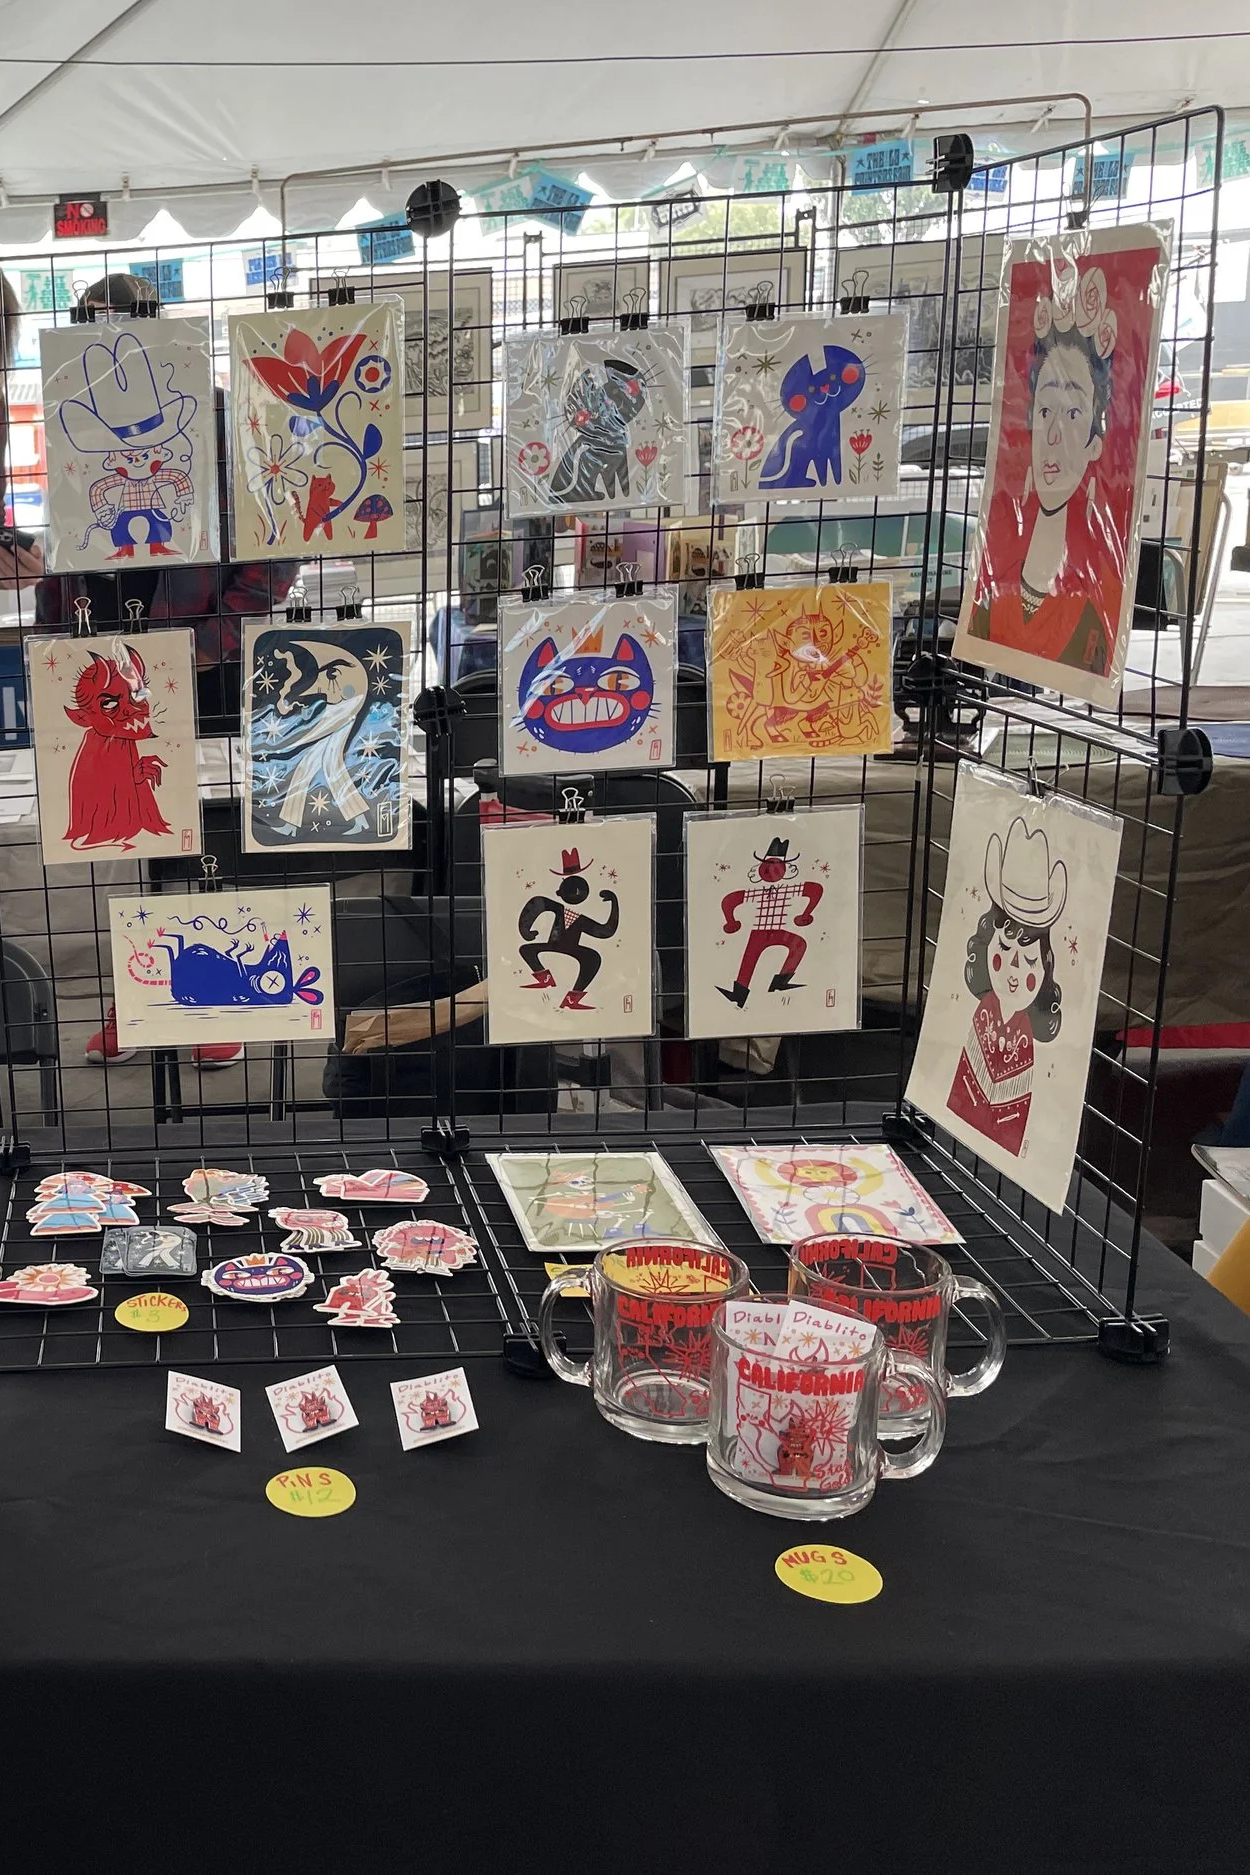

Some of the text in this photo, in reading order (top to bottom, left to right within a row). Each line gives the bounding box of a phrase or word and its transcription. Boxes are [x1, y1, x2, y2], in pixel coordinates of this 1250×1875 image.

[57, 218, 106, 237] SMOKING
[126, 1294, 187, 1312] STICKERS
[617, 1295, 723, 1328] CALIFORN
[733, 1310, 781, 1325] Diabl
[793, 1311, 867, 1341] Diablito
[736, 1357, 864, 1396] CALIFORNIA
[781, 1550, 847, 1568] MUGS
[799, 1568, 855, 1585] $20
